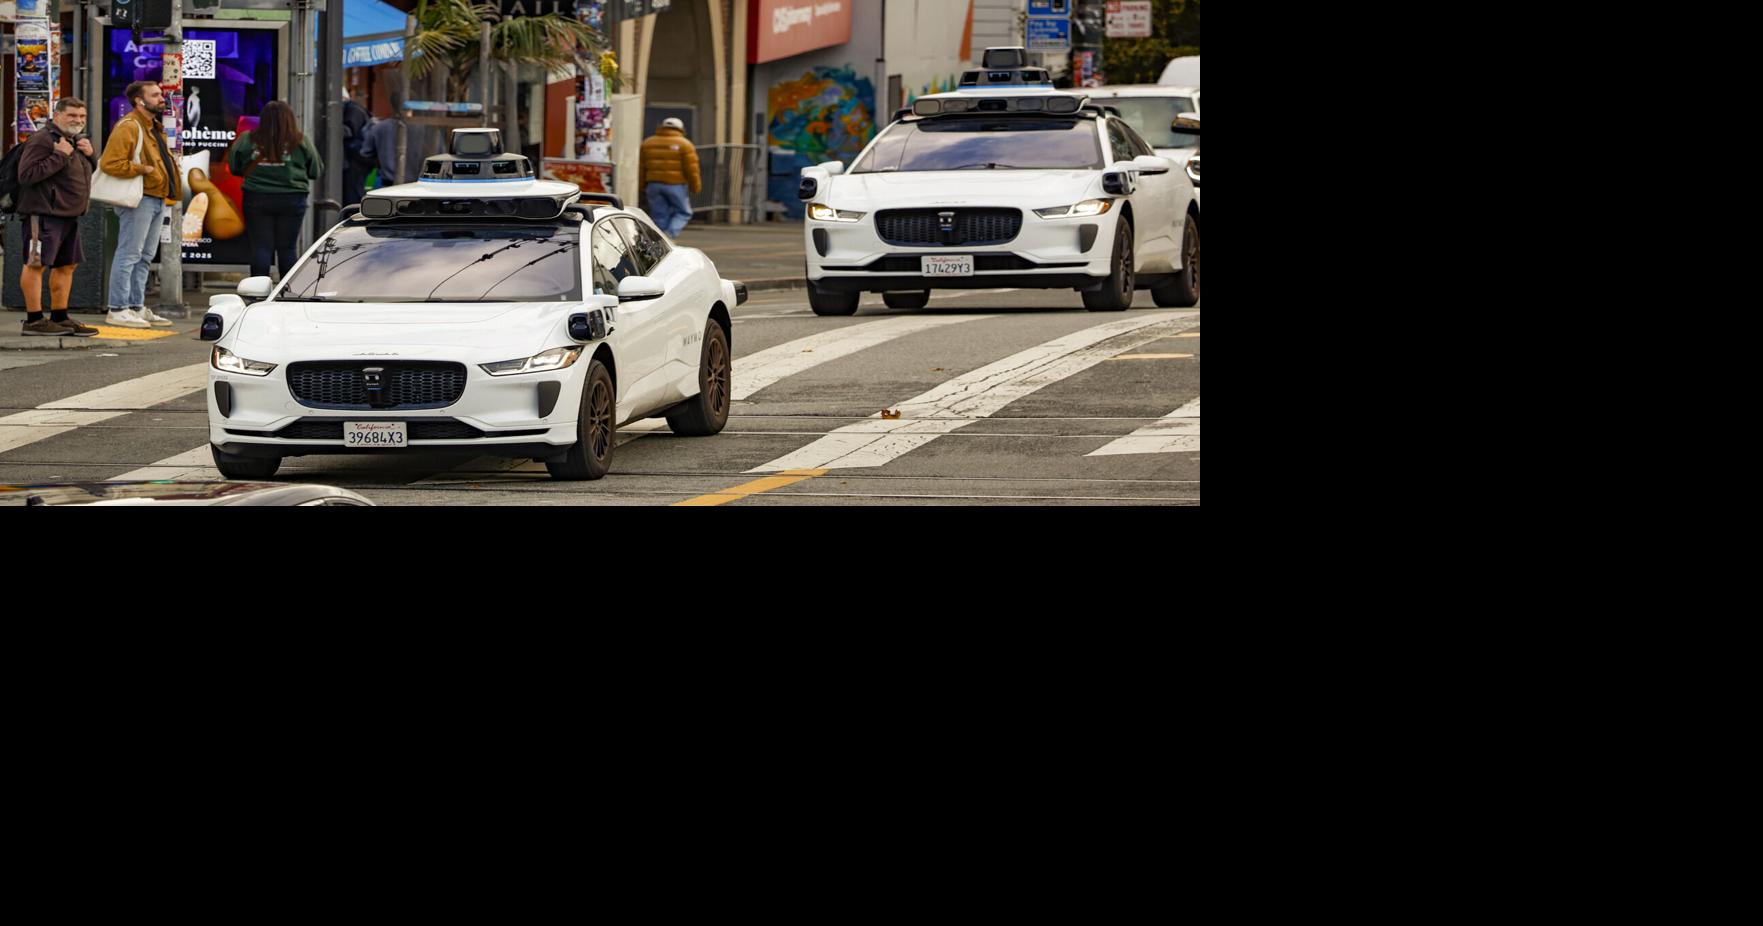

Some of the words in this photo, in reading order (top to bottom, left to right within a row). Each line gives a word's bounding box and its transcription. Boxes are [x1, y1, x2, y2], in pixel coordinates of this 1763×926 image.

[182, 126, 236, 140] ohème
[926, 263, 970, 274] 17429Y3
[357, 423, 393, 431] California
[348, 431, 403, 444] 39684X3
